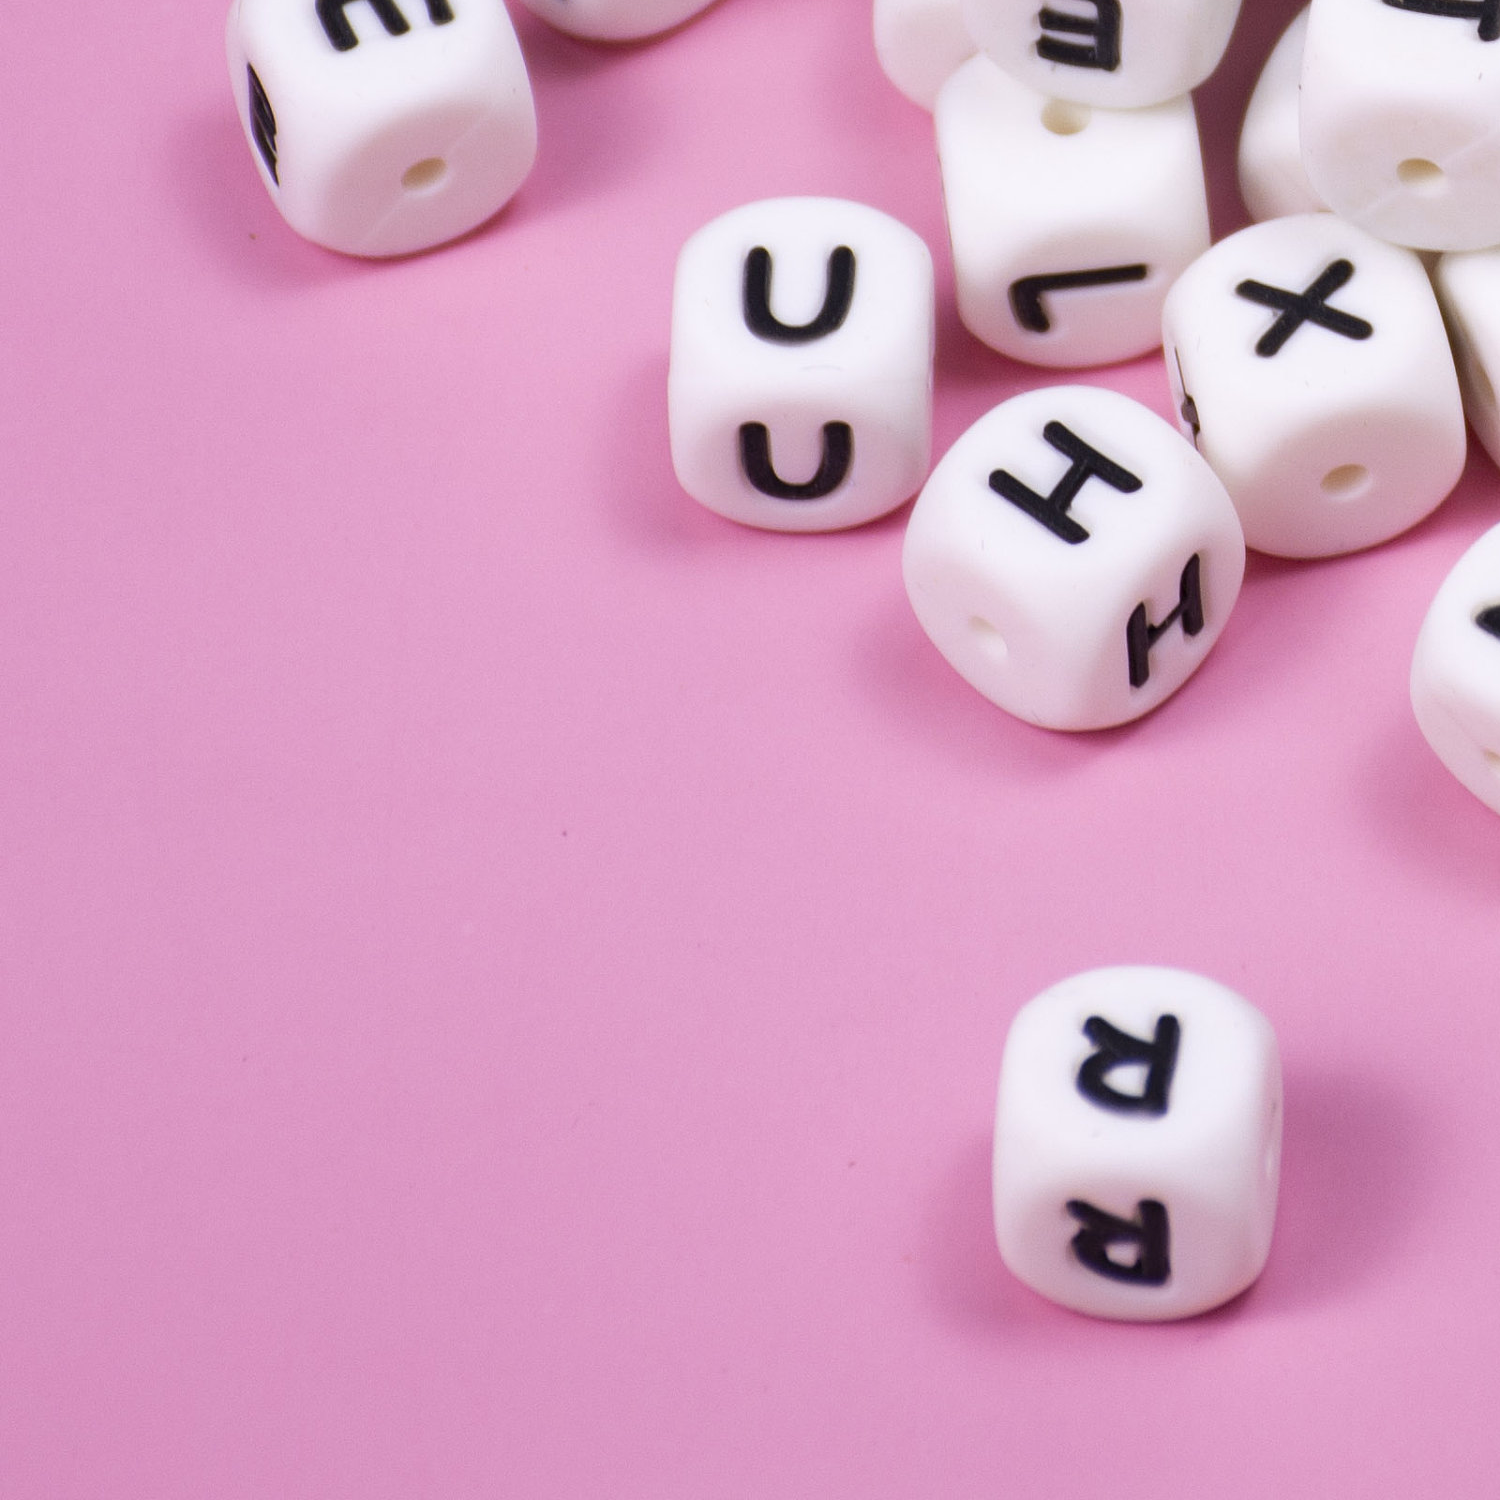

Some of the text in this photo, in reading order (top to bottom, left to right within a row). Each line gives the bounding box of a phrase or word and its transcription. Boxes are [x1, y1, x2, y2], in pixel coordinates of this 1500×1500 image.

[743, 245, 857, 344] U
[1008, 262, 1149, 335] L
[1236, 258, 1374, 358] X
[737, 420, 854, 502] U
[987, 420, 1144, 546] H
[1125, 551, 1206, 690] H
[1076, 1013, 1181, 1116] R
[1064, 1197, 1173, 1288] R
